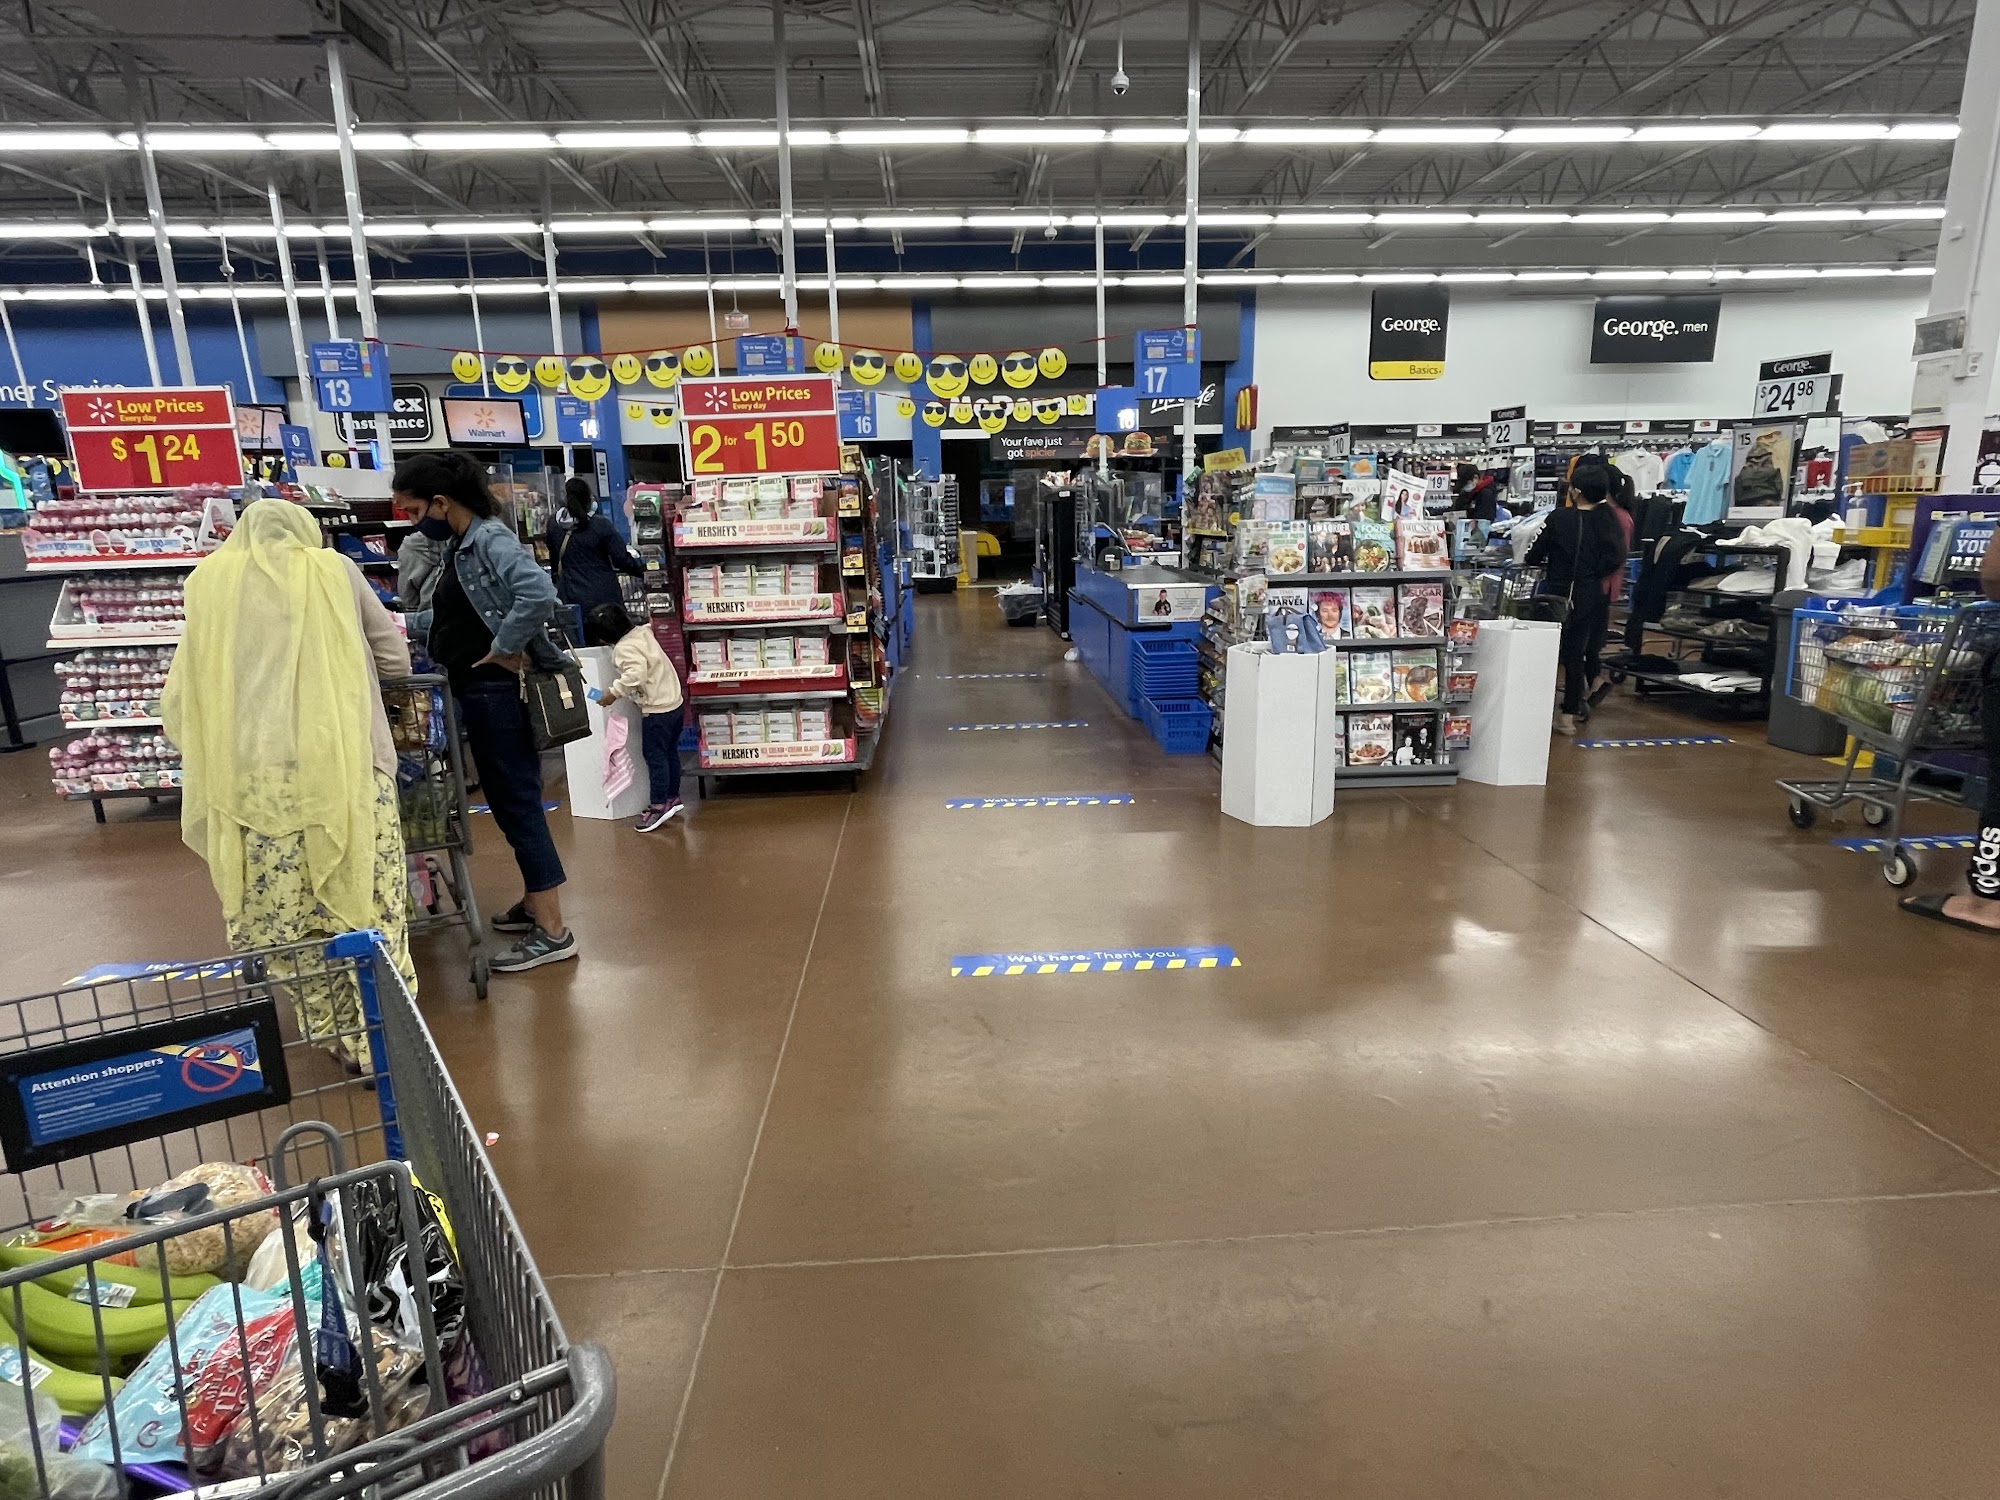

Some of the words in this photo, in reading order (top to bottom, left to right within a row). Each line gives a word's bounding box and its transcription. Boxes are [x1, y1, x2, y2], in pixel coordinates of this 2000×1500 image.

[1381, 317, 1441, 335] George.
[1603, 318, 1679, 341] George.
[1683, 323, 1708, 332] men
[1409, 364, 1438, 375] Basics
[1144, 366, 1168, 393] 17
[324, 379, 352, 407] 13
[731, 388, 762, 403] Low
[766, 386, 811, 402] Prices
[116, 399, 152, 414] Low
[154, 398, 205, 414] Prices
[733, 403, 752, 411] Every
[753, 402, 767, 410] day
[120, 414, 142, 423] Every
[142, 414, 157, 423] day
[341, 418, 425, 430] nsuance
[854, 415, 872, 434] 16
[467, 428, 506, 438] Walmart
[580, 419, 599, 439] 14
[240, 436, 273, 444] almart
[1001, 437, 1022, 447] Your
[1024, 436, 1043, 446] fave
[1044, 436, 1062, 448] just
[692, 424, 725, 473] 2
[724, 435, 738, 446] for
[1007, 449, 1024, 459] got
[1025, 448, 1056, 458] spicier
[698, 525, 737, 537] HERSHEY'S
[1408, 588, 1442, 597] SUGAR
[706, 601, 745, 613] HERSHEY'S
[711, 670, 749, 678] HERSHEY'S
[1351, 722, 1392, 731] ITALIAN
[722, 747, 759, 759] HERSHEY'S
[1008, 954, 1045, 963] Wait
[1049, 953, 1091, 962] here.
[1094, 951, 1142, 960] Thank
[1146, 951, 1180, 960] you.
[31, 1070, 99, 1094] Attention
[101, 1056, 165, 1078] shoppers
